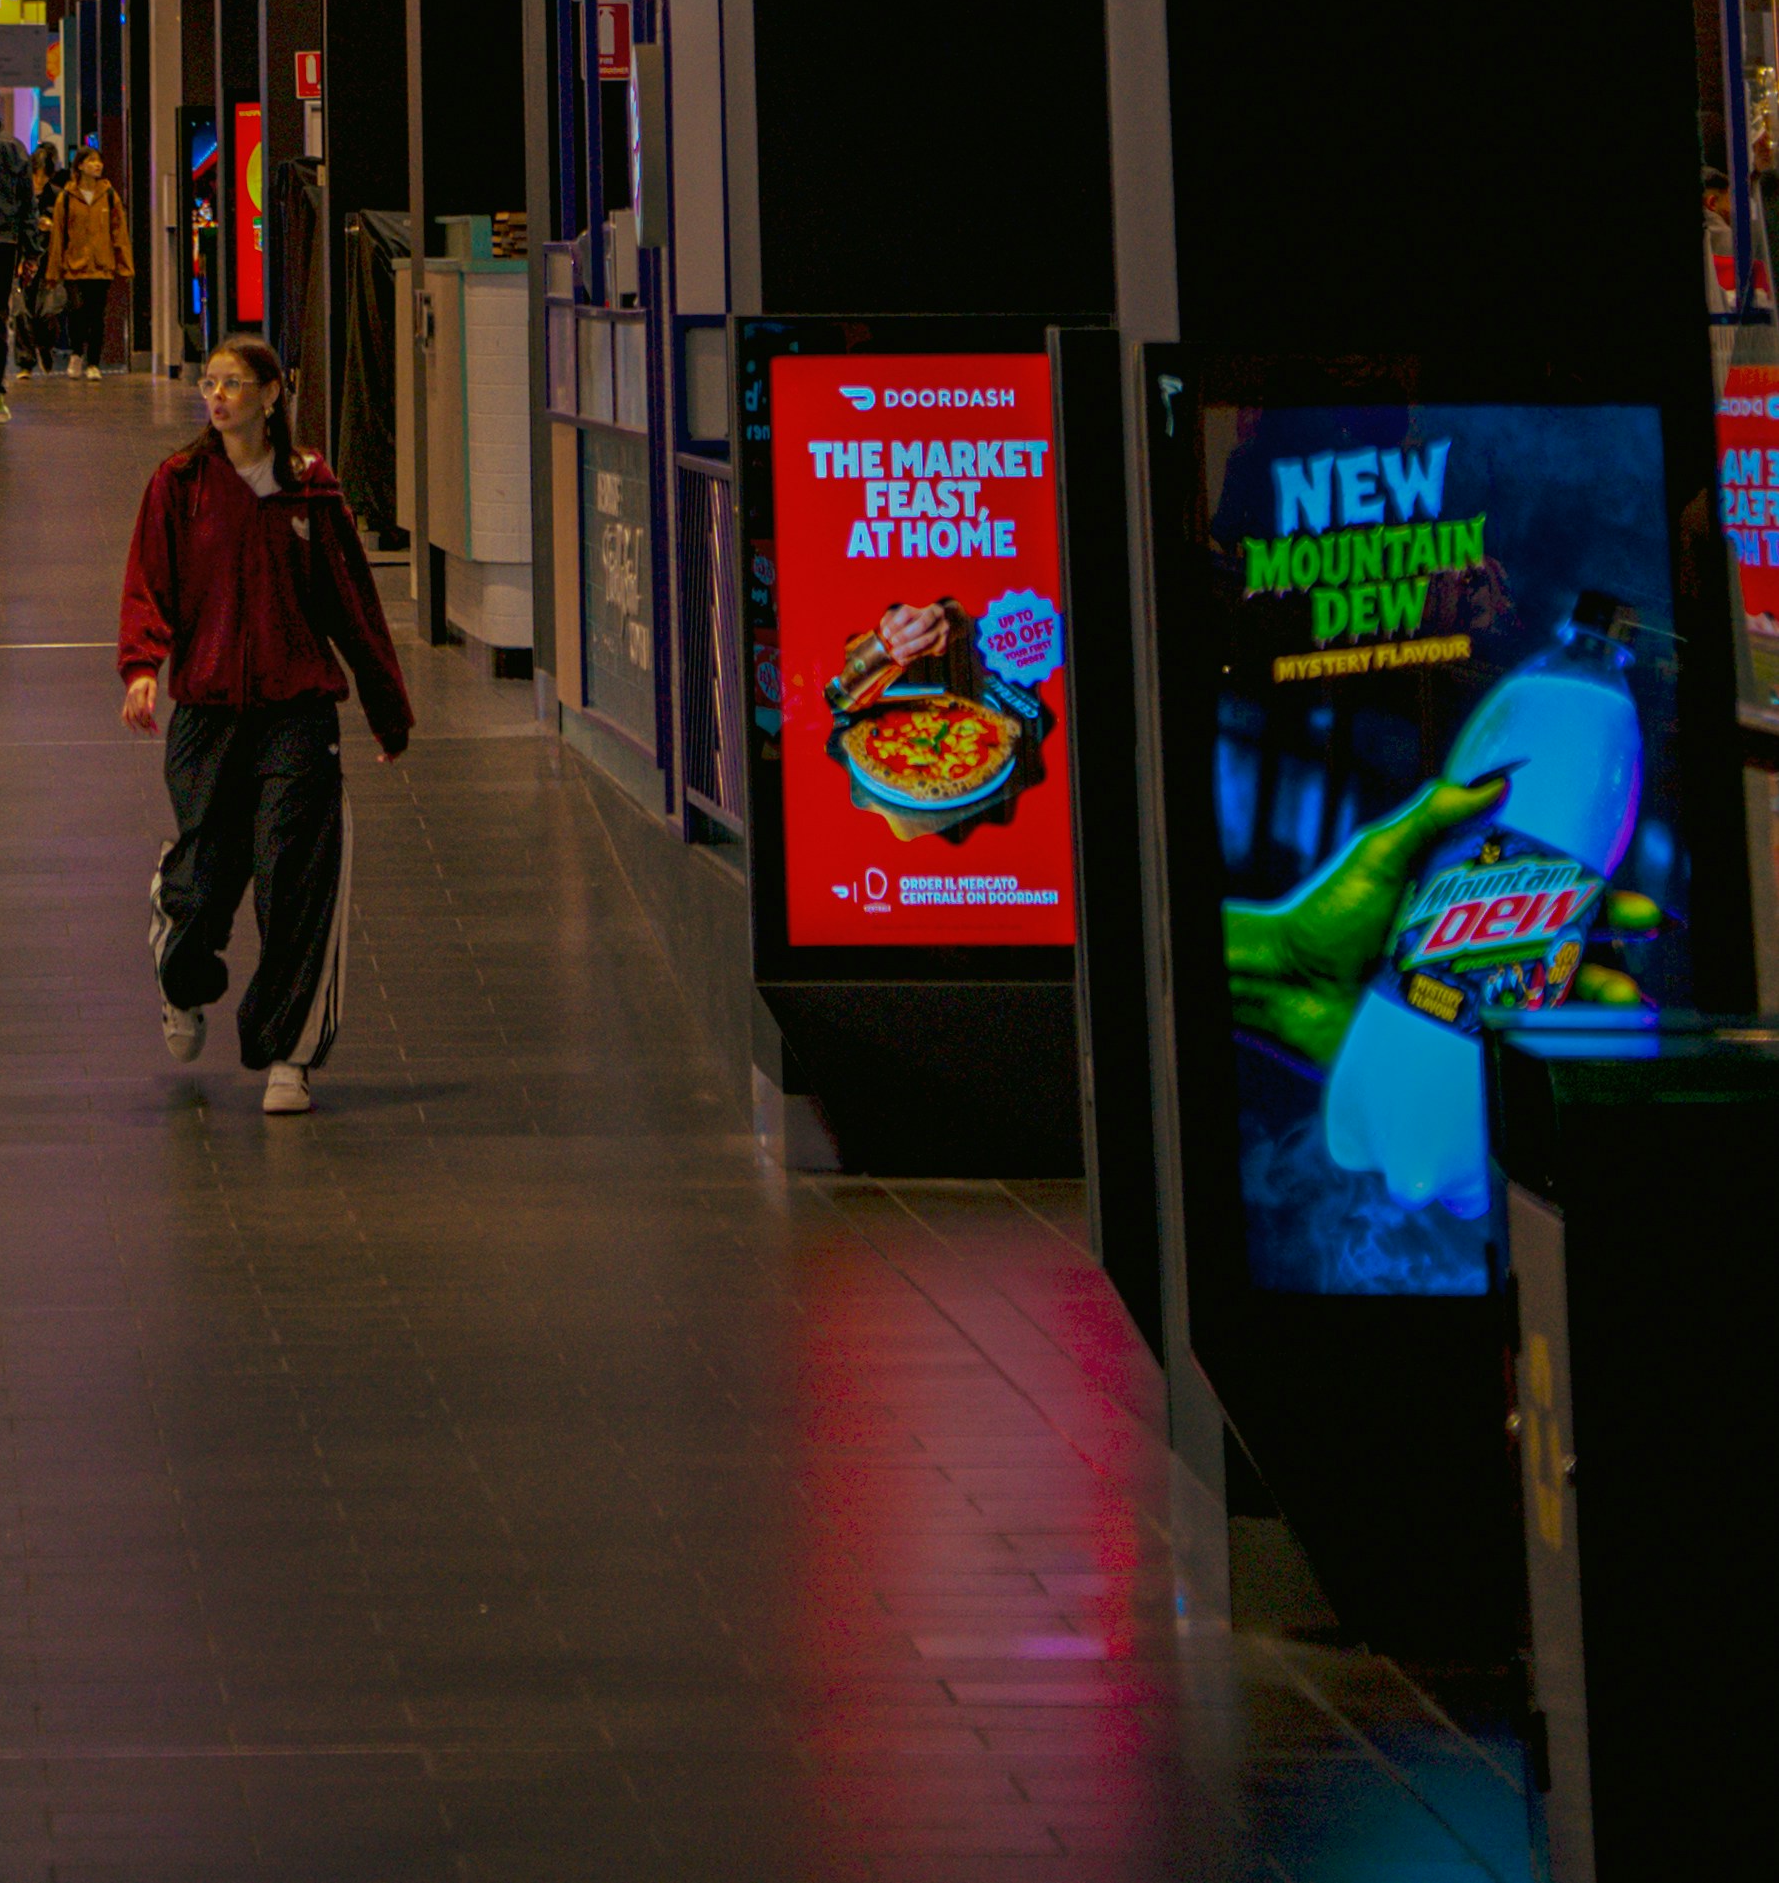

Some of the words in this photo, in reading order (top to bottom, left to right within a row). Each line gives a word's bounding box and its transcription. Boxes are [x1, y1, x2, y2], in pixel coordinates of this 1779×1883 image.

[884, 388, 1015, 408] DOORDASH
[808, 440, 884, 479] THE
[891, 440, 1049, 478] MARKET
[865, 480, 990, 524] FEAST,
[1274, 436, 1453, 539] NEW
[846, 520, 894, 558] AT
[901, 520, 1017, 558] HOME
[1242, 512, 1486, 600] MOUNTAIN
[998, 615, 1015, 628] UP
[1016, 609, 1034, 623] TO
[1310, 576, 1430, 650] DEW
[987, 630, 1018, 652] $20
[1019, 618, 1055, 644] OFF
[1005, 647, 1028, 661] YOUR
[1029, 639, 1052, 653] FIRST
[1016, 652, 1046, 668] ORDER
[1275, 650, 1372, 683] MYSTERY
[1372, 635, 1470, 671] FLAVOUR
[899, 876, 942, 891] ORDER
[945, 876, 956, 891] IL
[958, 876, 1018, 891] MERCATO
[900, 890, 963, 905] CENTRALE
[966, 890, 986, 905] ON
[989, 890, 1059, 905] DOORDASH
[1406, 863, 1581, 926] Mountain
